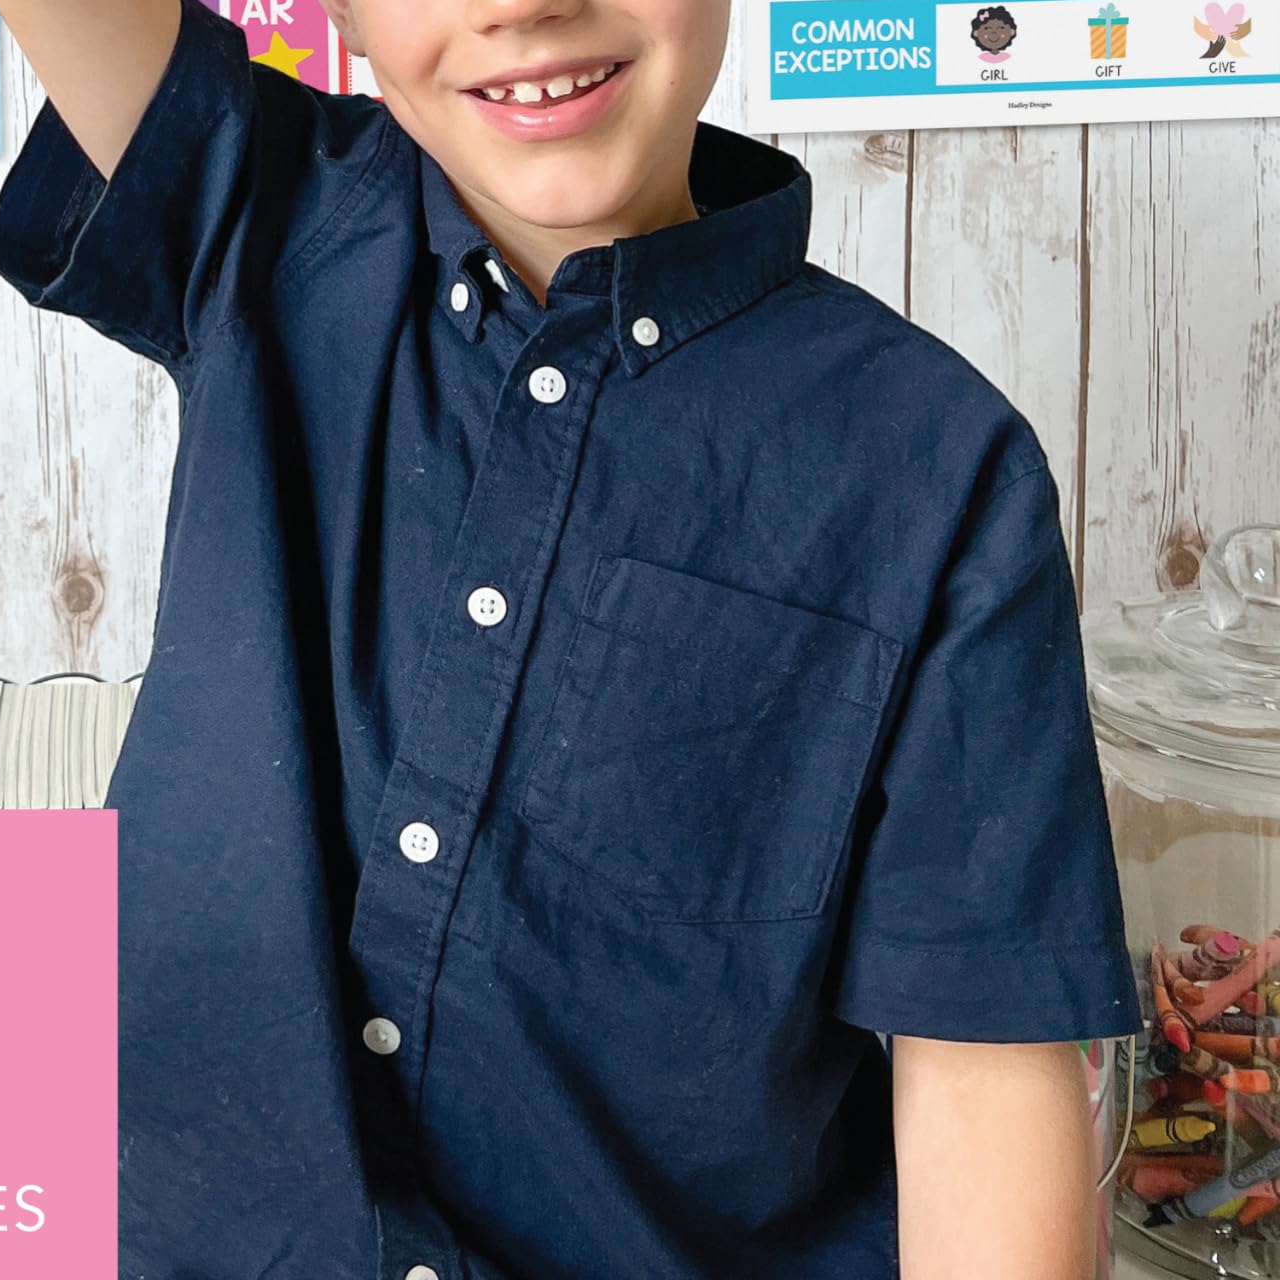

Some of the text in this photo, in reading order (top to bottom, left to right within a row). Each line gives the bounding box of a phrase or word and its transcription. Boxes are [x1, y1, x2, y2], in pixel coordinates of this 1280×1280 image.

[792, 18, 914, 44] COMMON
[775, 47, 931, 73] EXCEPTIONS
[1209, 61, 1236, 73] GIVE
[981, 69, 1008, 81] GIRL
